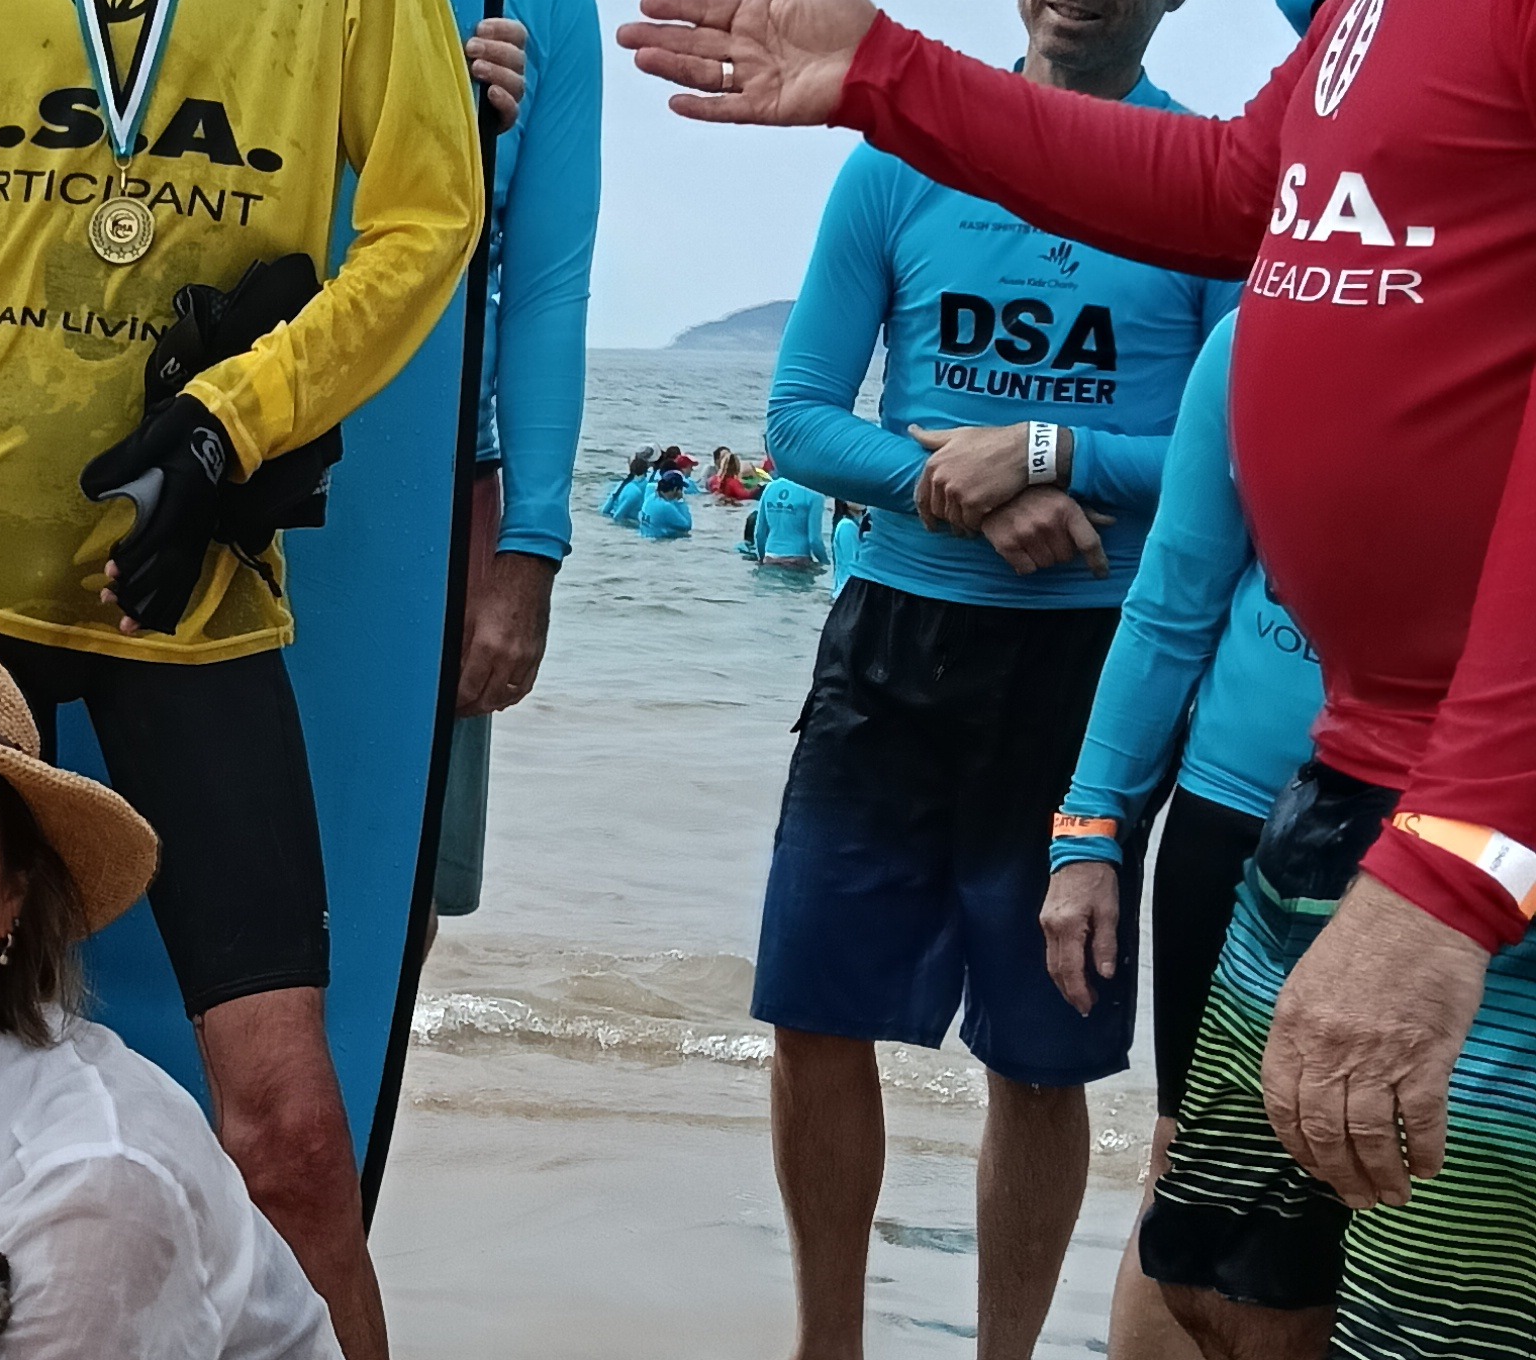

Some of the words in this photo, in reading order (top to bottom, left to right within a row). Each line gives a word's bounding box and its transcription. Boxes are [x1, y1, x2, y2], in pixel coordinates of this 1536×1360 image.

[1253, 258, 1424, 306] LEADER
[63, 311, 169, 343] LIVIN
[938, 291, 1118, 372] DSA
[935, 360, 1117, 405] VOLUNTEER
